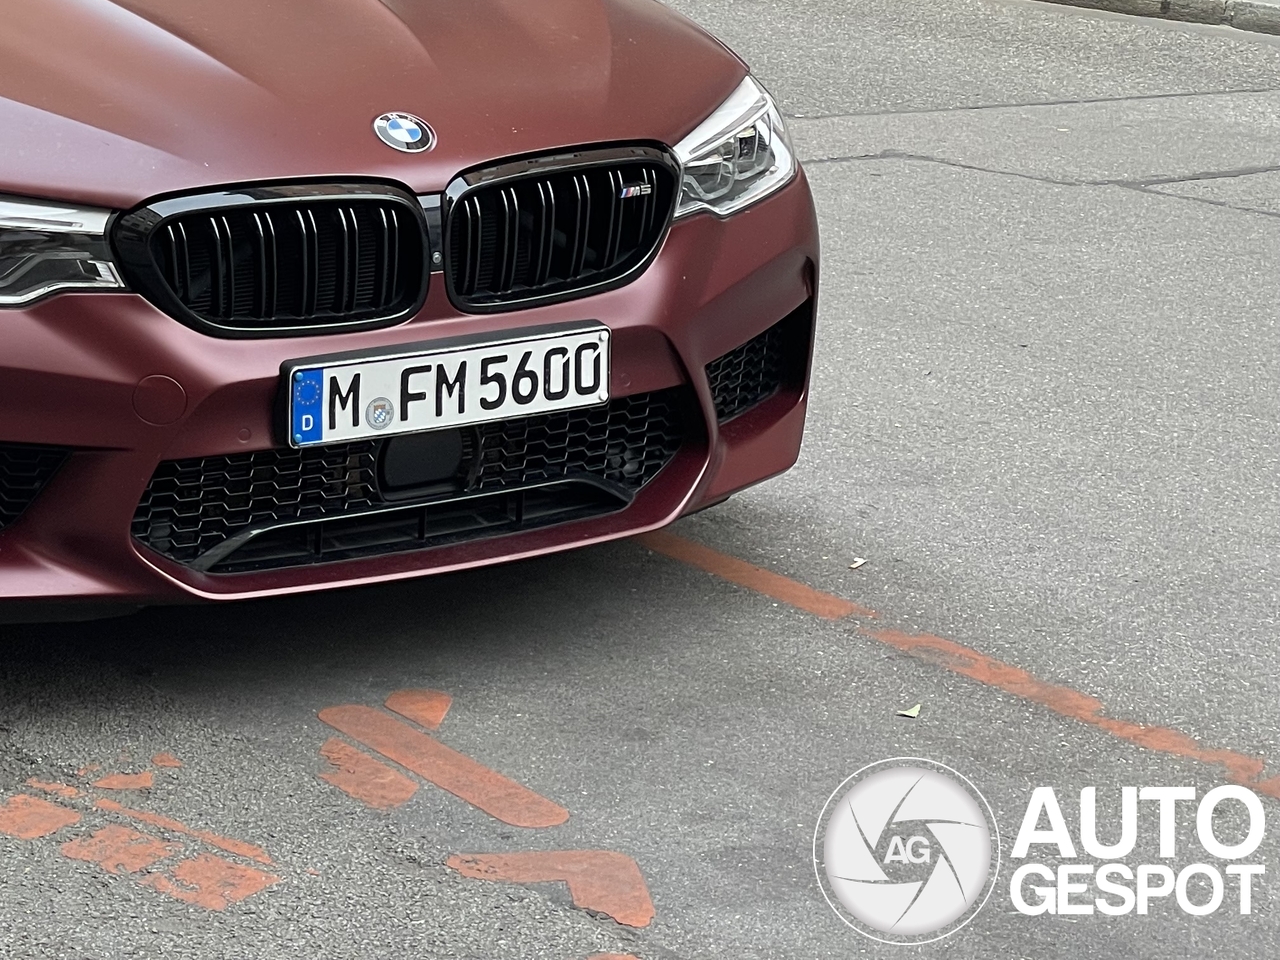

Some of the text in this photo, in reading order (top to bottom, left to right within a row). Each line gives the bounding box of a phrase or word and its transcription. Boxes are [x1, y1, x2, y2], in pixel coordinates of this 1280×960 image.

[302, 414, 314, 431] D
[328, 372, 361, 430] M
[399, 360, 467, 421] FM
[479, 342, 600, 411] 5600
